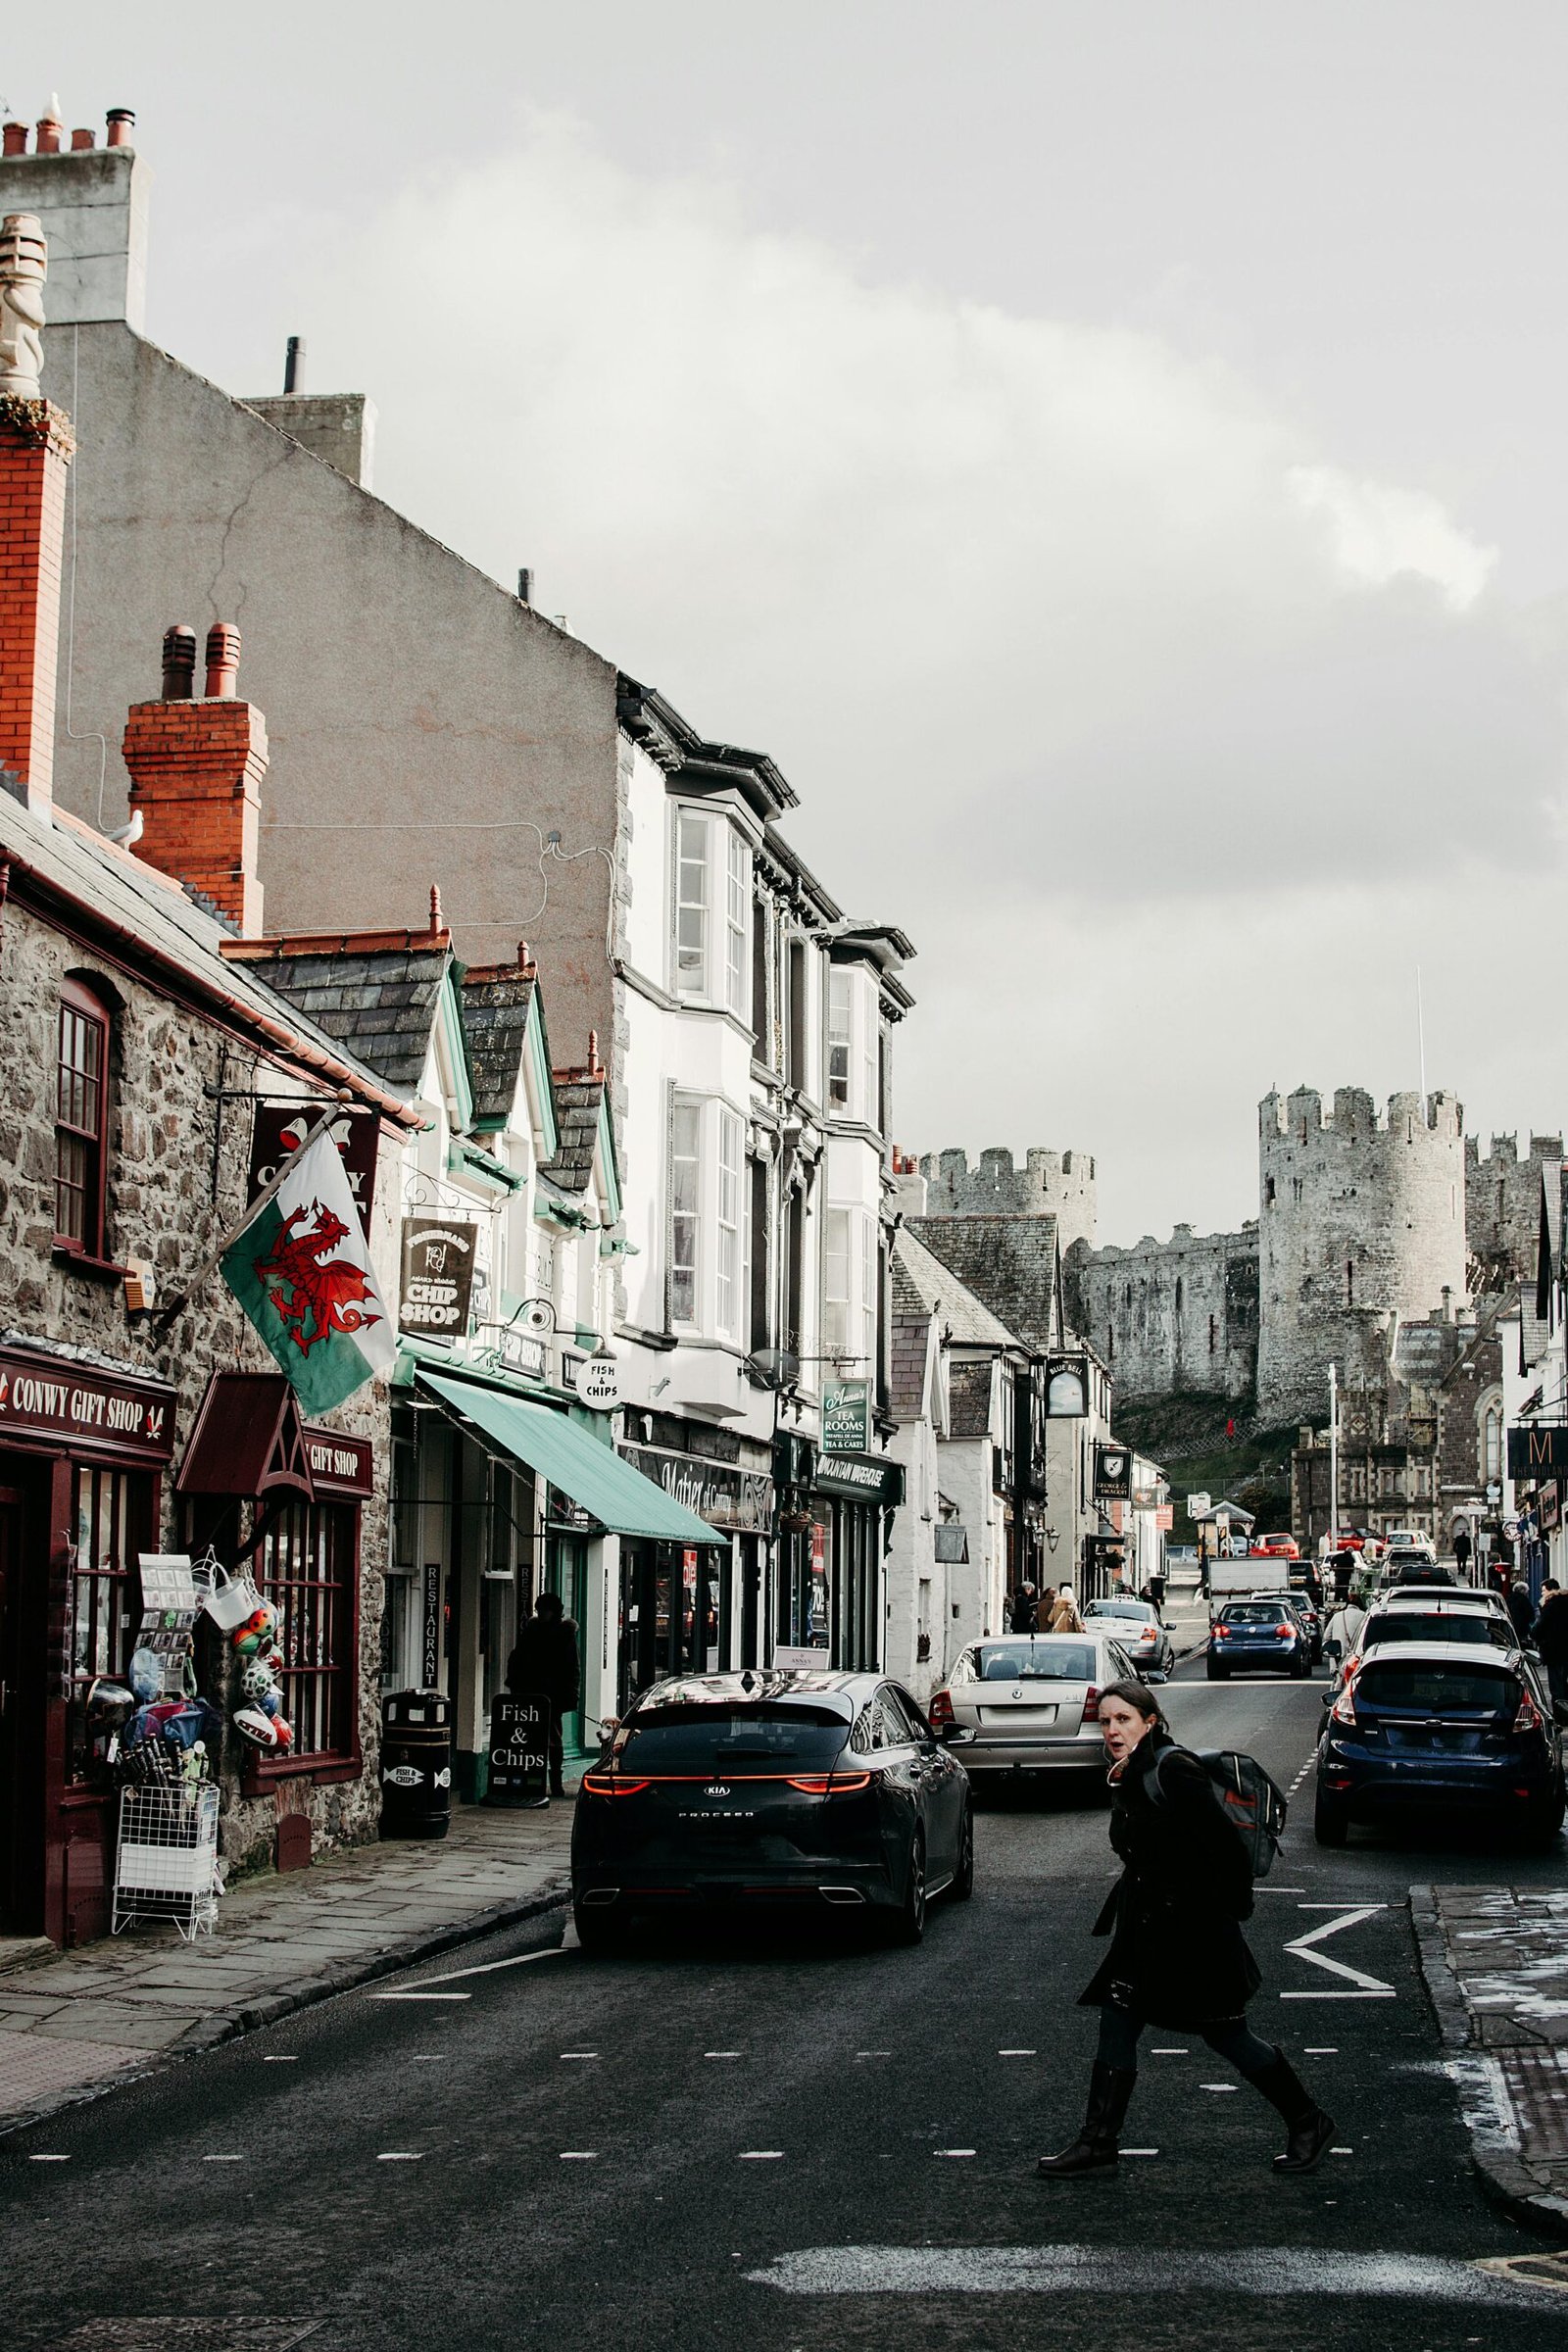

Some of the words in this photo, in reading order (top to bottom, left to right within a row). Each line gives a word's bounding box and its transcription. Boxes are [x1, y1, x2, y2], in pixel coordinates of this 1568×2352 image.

[406, 1283, 459, 1305] CHIP
[399, 1302, 461, 1325] SHOP
[591, 1365, 615, 1376] FISH
[1049, 1363, 1066, 1375] BLUE
[1067, 1363, 1083, 1376] BELL
[586, 1386, 617, 1396] CHIPS
[826, 1387, 865, 1410] Anna's
[13, 1376, 70, 1418] CONWY
[71, 1388, 106, 1426] GIFT
[107, 1396, 144, 1433] SHOP
[825, 1421, 864, 1431] ROOMS
[837, 1411, 855, 1421] TEA
[1529, 1431, 1552, 1464] M
[311, 1445, 333, 1473] GIFT
[334, 1449, 358, 1477] SHOP
[851, 1463, 885, 1488] WAREHOUSE
[425, 1567, 437, 1685] RESTAURANT
[501, 1704, 539, 1723] Fish
[510, 1727, 528, 1744] &
[491, 1748, 545, 1771] Chips
[395, 1776, 416, 1785] CHIPS
[708, 1786, 726, 1794] KIA
